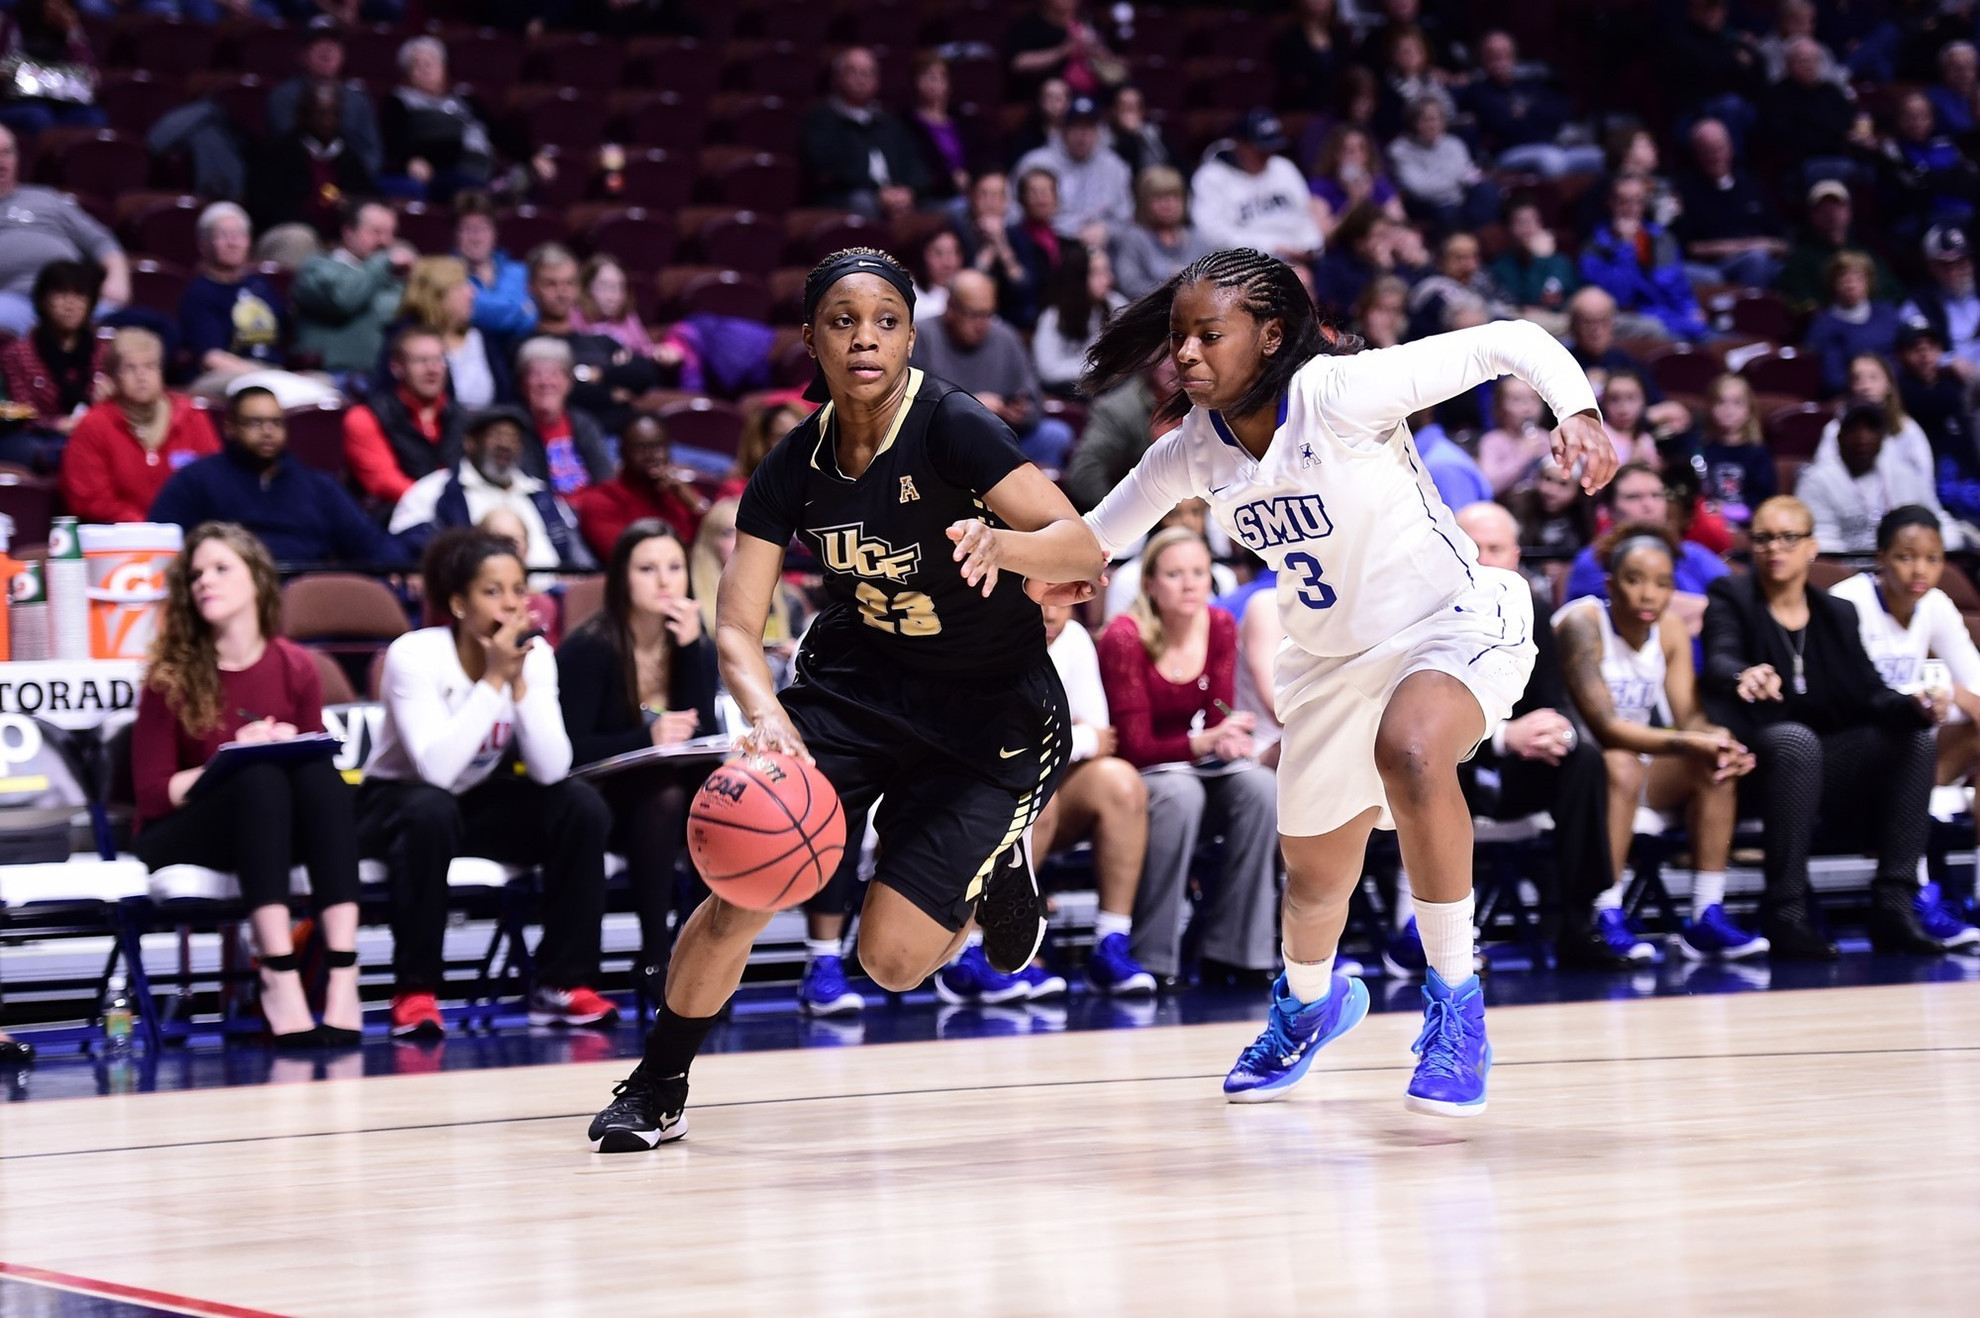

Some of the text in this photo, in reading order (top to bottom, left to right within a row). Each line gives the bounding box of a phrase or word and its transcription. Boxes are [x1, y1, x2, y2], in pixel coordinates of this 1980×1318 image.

[900, 475, 921, 504] A
[1234, 494, 1334, 550] SMU
[805, 521, 922, 585] UCF
[1284, 552, 1337, 609] 3
[855, 581, 942, 636] 23
